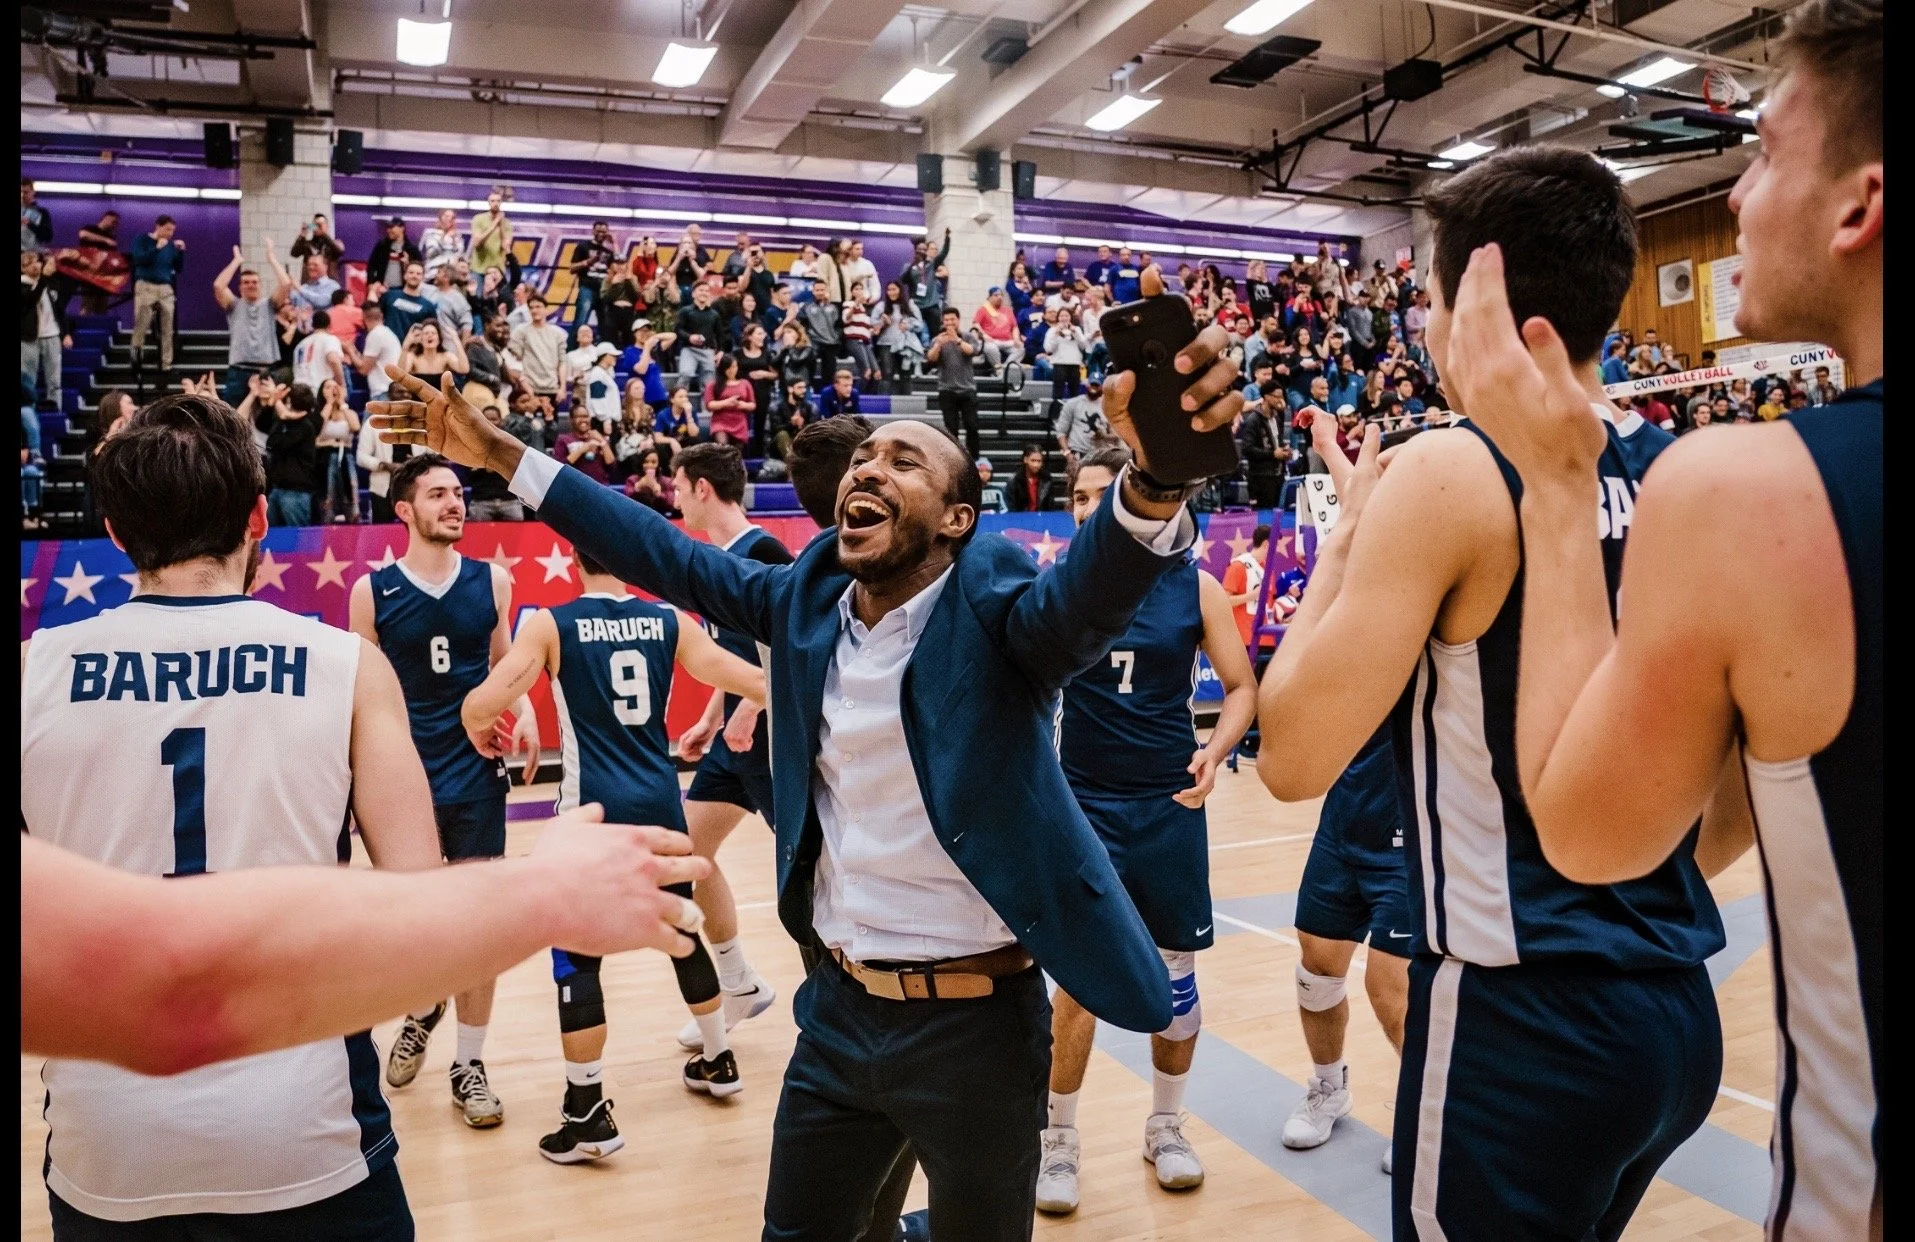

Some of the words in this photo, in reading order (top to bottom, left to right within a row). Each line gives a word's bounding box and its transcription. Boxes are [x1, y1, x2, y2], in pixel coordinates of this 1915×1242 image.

[430, 635, 451, 674] 6
[574, 617, 665, 643] BARUCH
[70, 643, 308, 703] BARUCH
[609, 649, 652, 726] 9
[1110, 651, 1135, 694] 7
[160, 726, 217, 879] 1
